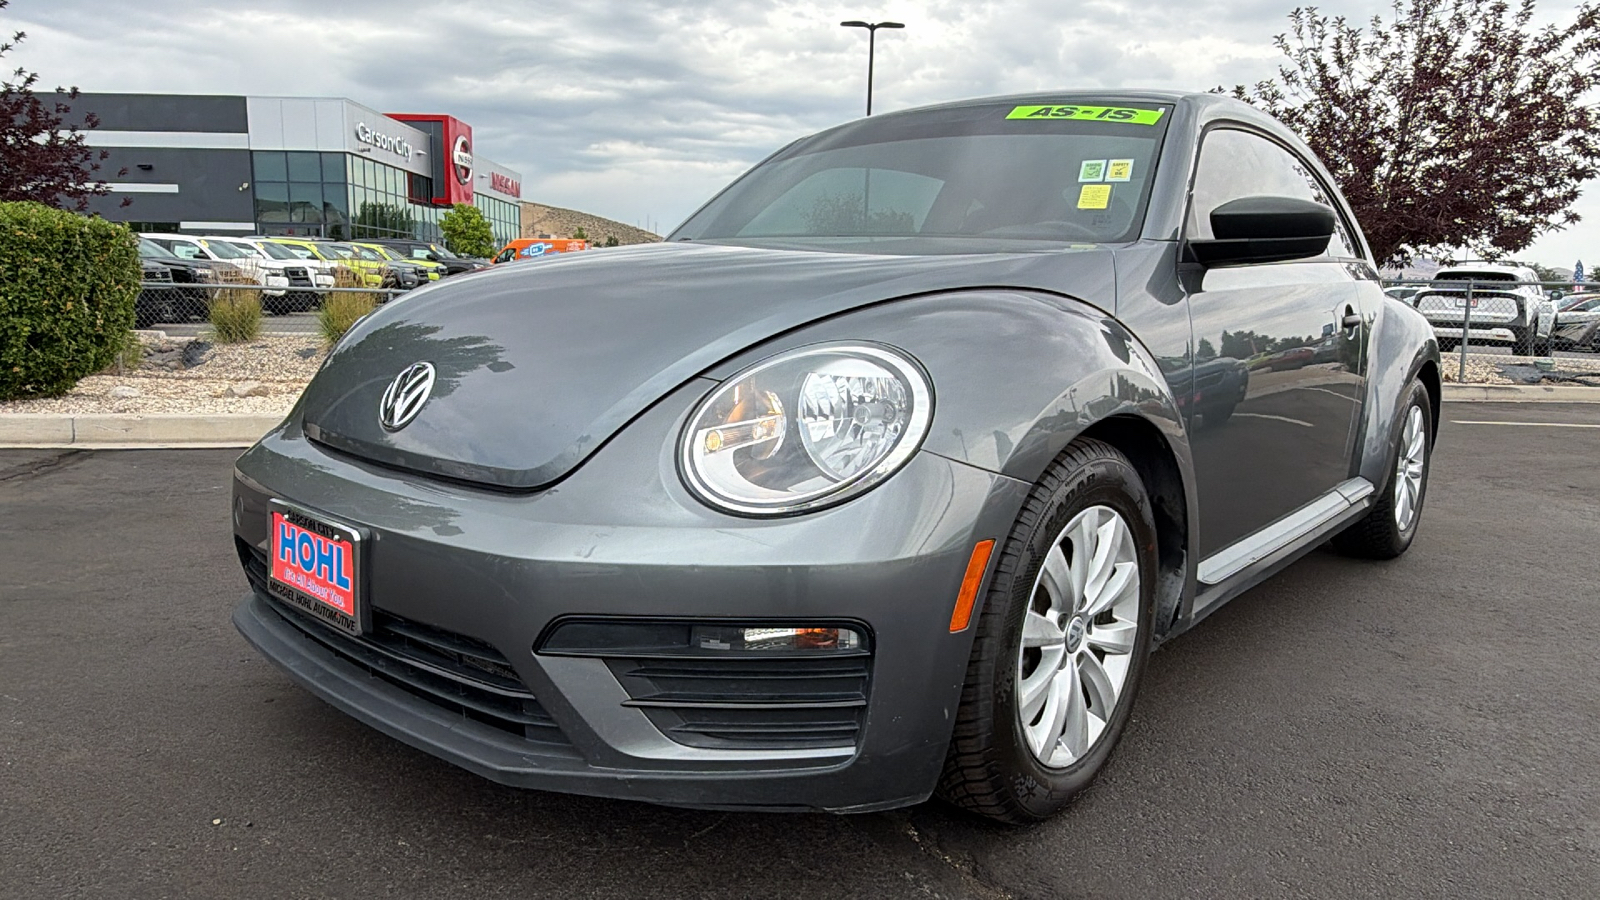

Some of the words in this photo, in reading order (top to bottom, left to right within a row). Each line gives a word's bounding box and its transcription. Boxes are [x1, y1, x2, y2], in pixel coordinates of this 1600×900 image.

[355, 122, 394, 151] Carson
[395, 136, 413, 162] City
[316, 522, 335, 540] CITY
[279, 522, 350, 591] HOHL
[284, 567, 296, 582] It's
[296, 573, 306, 587] All
[305, 578, 328, 599] About
[269, 580, 295, 602] MICHAEL
[295, 591, 313, 611] HOHL
[313, 603, 356, 631] AUTOMOTIVE
